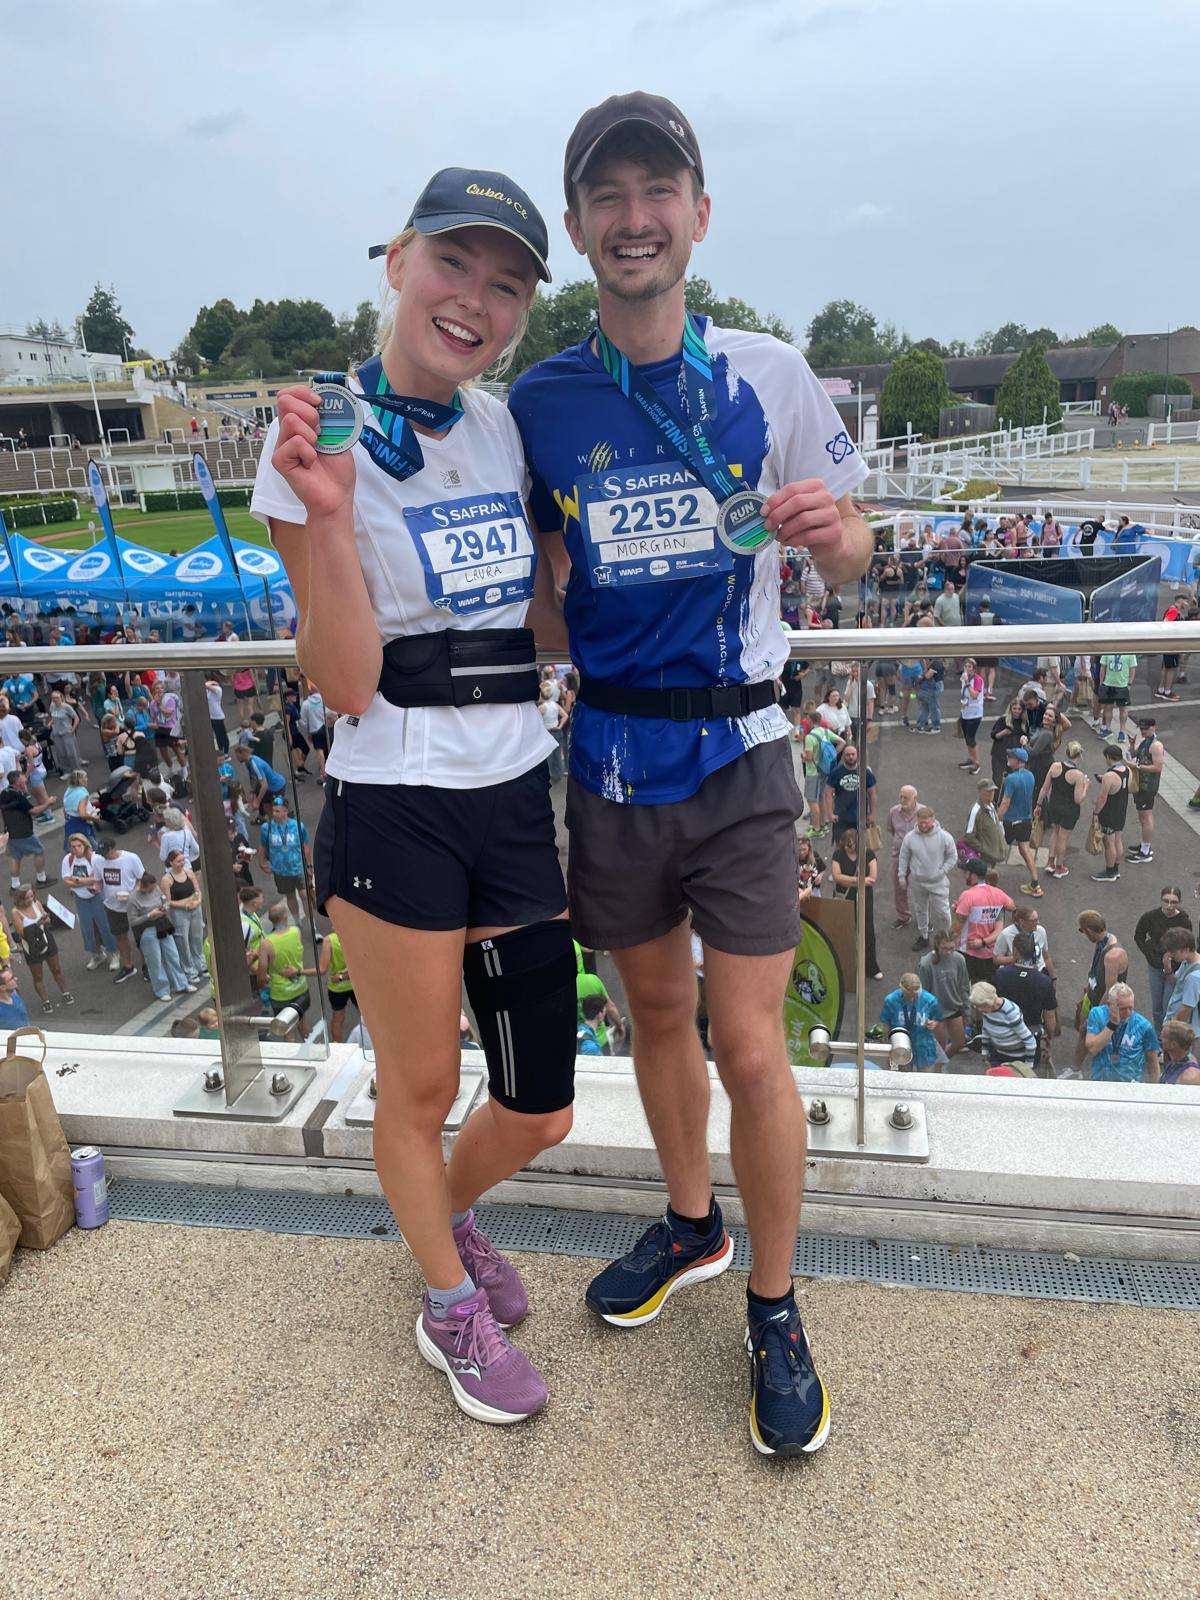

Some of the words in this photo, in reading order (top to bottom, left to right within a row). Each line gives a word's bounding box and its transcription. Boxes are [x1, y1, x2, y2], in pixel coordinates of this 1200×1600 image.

[634, 391, 662, 425] MARATHON
[696, 437, 715, 465] RUN
[625, 470, 697, 491] SAFRAN
[449, 501, 507, 521] SAFRAN
[608, 494, 701, 536] 2252
[730, 501, 755, 526] RUN
[444, 522, 517, 565] 2947
[616, 538, 686, 558] MORGAN
[465, 565, 502, 583] LAURA
[618, 567, 643, 577] WMP
[457, 596, 480, 607] WMP
